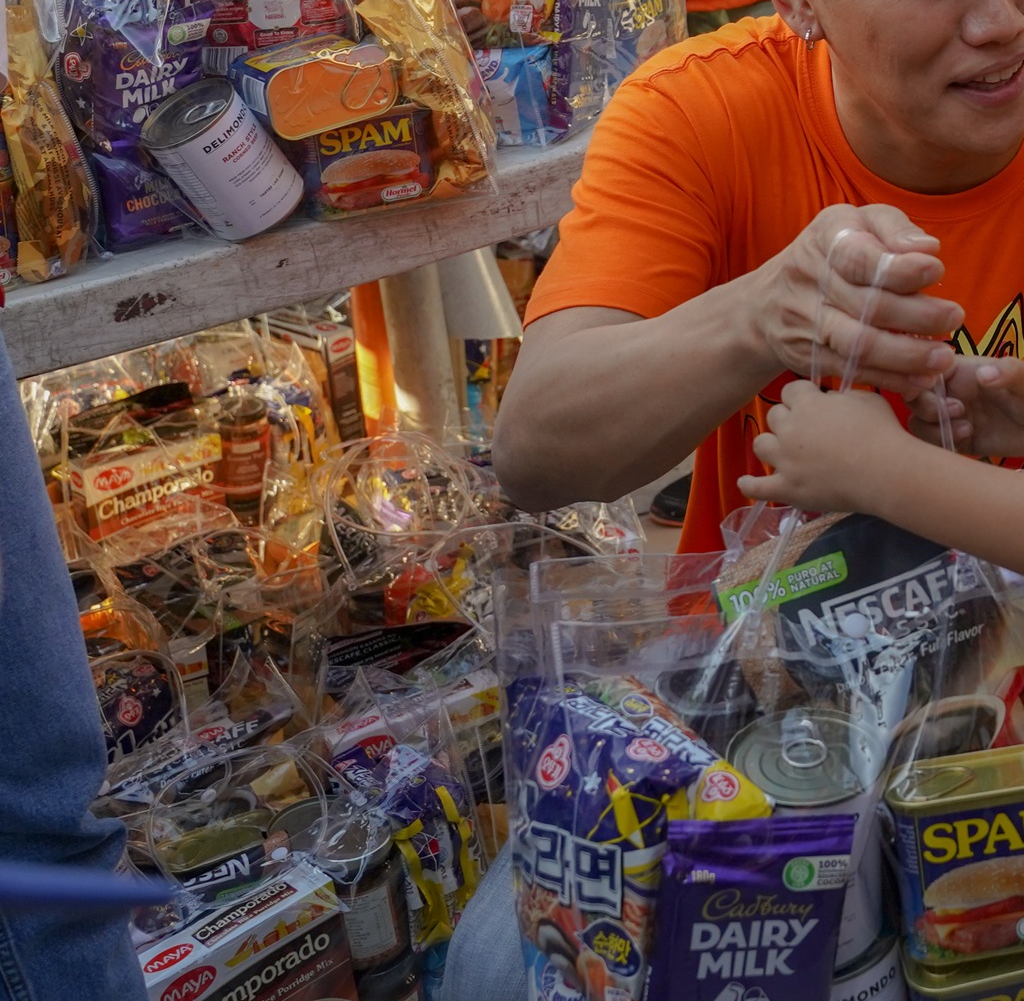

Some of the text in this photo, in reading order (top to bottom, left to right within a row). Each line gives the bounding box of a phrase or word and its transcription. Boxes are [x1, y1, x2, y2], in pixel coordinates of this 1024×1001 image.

[115, 57, 189, 90] DAIRY
[481, 60, 499, 79] AND
[122, 76, 178, 109] MILK
[319, 117, 413, 156] SPAM
[222, 139, 246, 164] RANCH
[126, 196, 171, 212] CHOCO
[385, 185, 417, 197] Hormel
[94, 470, 133, 489] MAYA
[788, 567, 818, 585] PURO
[819, 560, 834, 575] AT
[790, 569, 841, 593] NATURAL
[947, 622, 985, 647] Flavor
[526, 820, 622, 920] 라면
[818, 859, 848, 869] 100%
[817, 877, 847, 886] COCOA
[195, 882, 288, 941] Champorado
[254, 898, 280, 915] Porridge
[280, 889, 295, 901] Mix
[701, 888, 815, 921] Cadbury
[690, 918, 820, 951] DAIRY
[146, 944, 194, 973] MAYA
[220, 932, 331, 1001] mporado
[696, 949, 795, 980] MILK
[162, 970, 215, 1001] MAYA
[277, 970, 315, 997] Porridge
[316, 958, 335, 973] Mix
